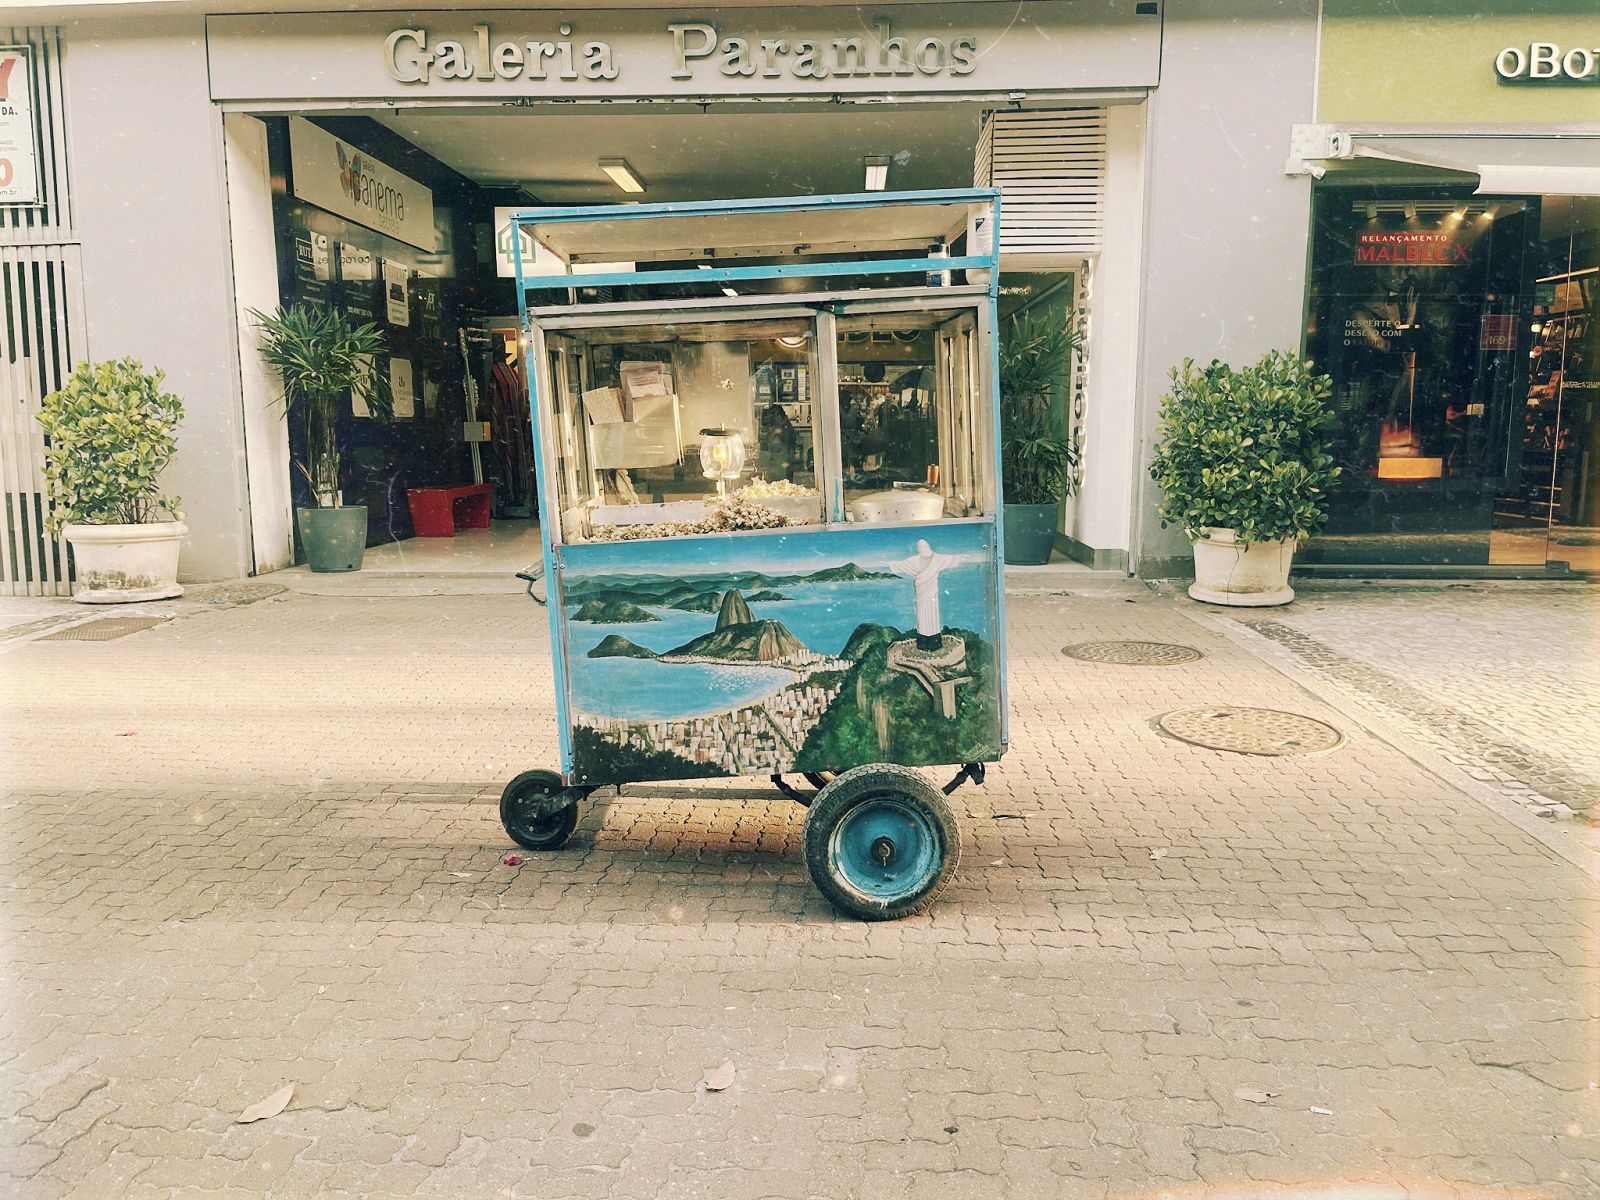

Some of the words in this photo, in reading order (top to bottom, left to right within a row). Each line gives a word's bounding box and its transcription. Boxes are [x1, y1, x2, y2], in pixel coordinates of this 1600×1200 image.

[383, 24, 620, 84] Galeria
[668, 18, 977, 80] Paranhos
[1361, 235, 1448, 243] RELANÇAMENTO
[1357, 245, 1448, 262] MALBEC
[1381, 329, 1402, 337] COM
